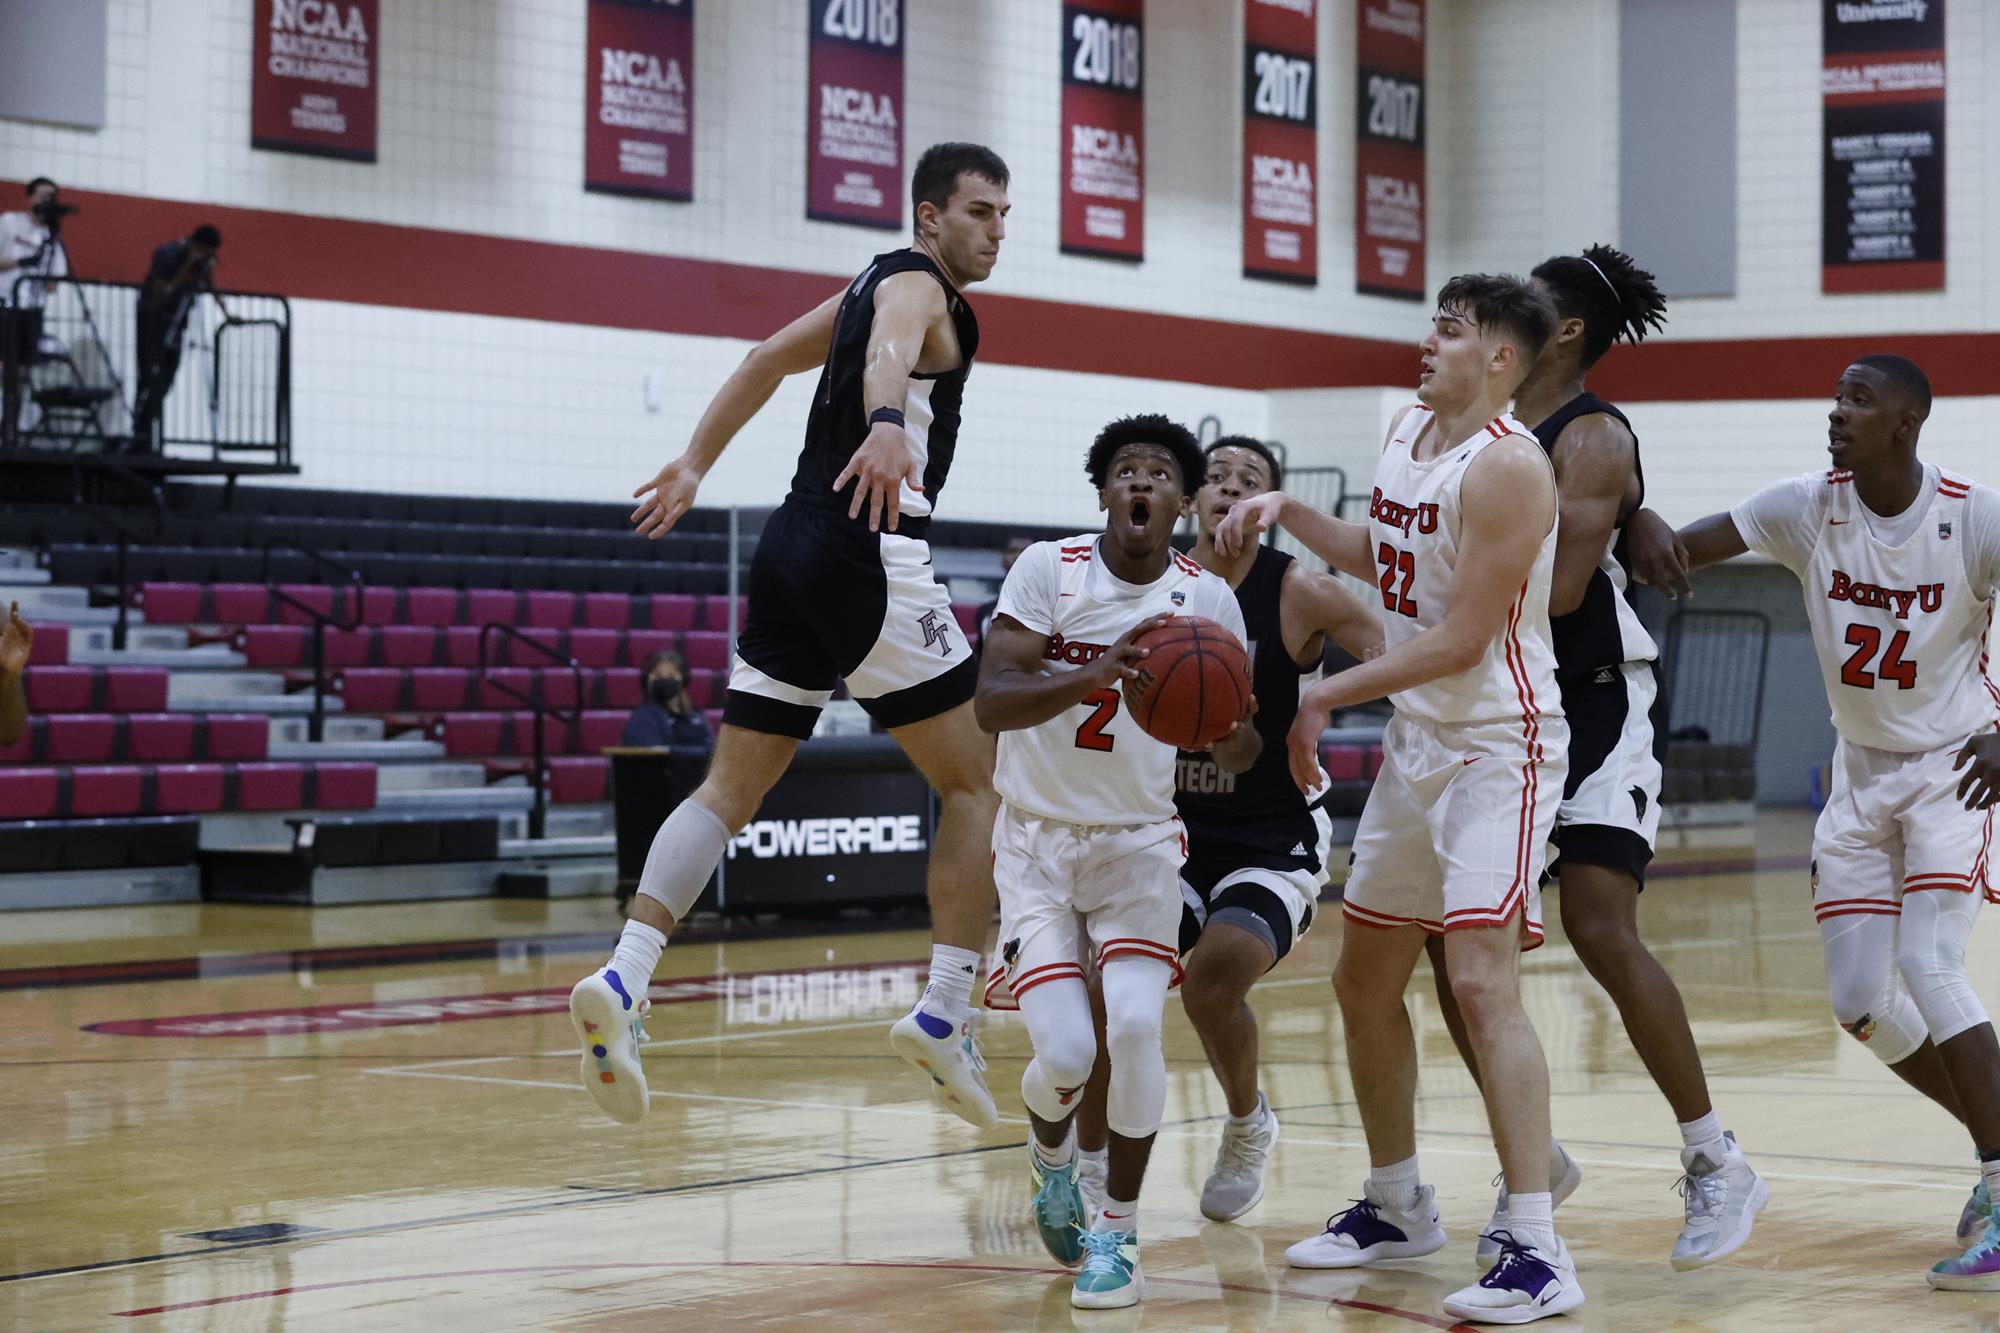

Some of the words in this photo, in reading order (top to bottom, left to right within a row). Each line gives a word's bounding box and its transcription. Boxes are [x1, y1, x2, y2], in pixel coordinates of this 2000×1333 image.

[270, 0, 368, 43] NCAA
[823, 0, 898, 46] 2018
[1836, 1, 1928, 23] University
[602, 47, 686, 92] NCAA
[1073, 14, 1140, 88] 2018
[821, 84, 897, 127] NCAA
[1254, 51, 1312, 120] 2017
[1368, 76, 1420, 142] 2017
[1072, 124, 1139, 163] NCAA
[1252, 154, 1312, 191] NCAA
[1378, 541, 1418, 618] 22
[1841, 623, 1918, 690] 24
[1075, 687, 1121, 752] 2
[1176, 758, 1236, 794] TECH
[727, 815, 921, 860] POWERADE
